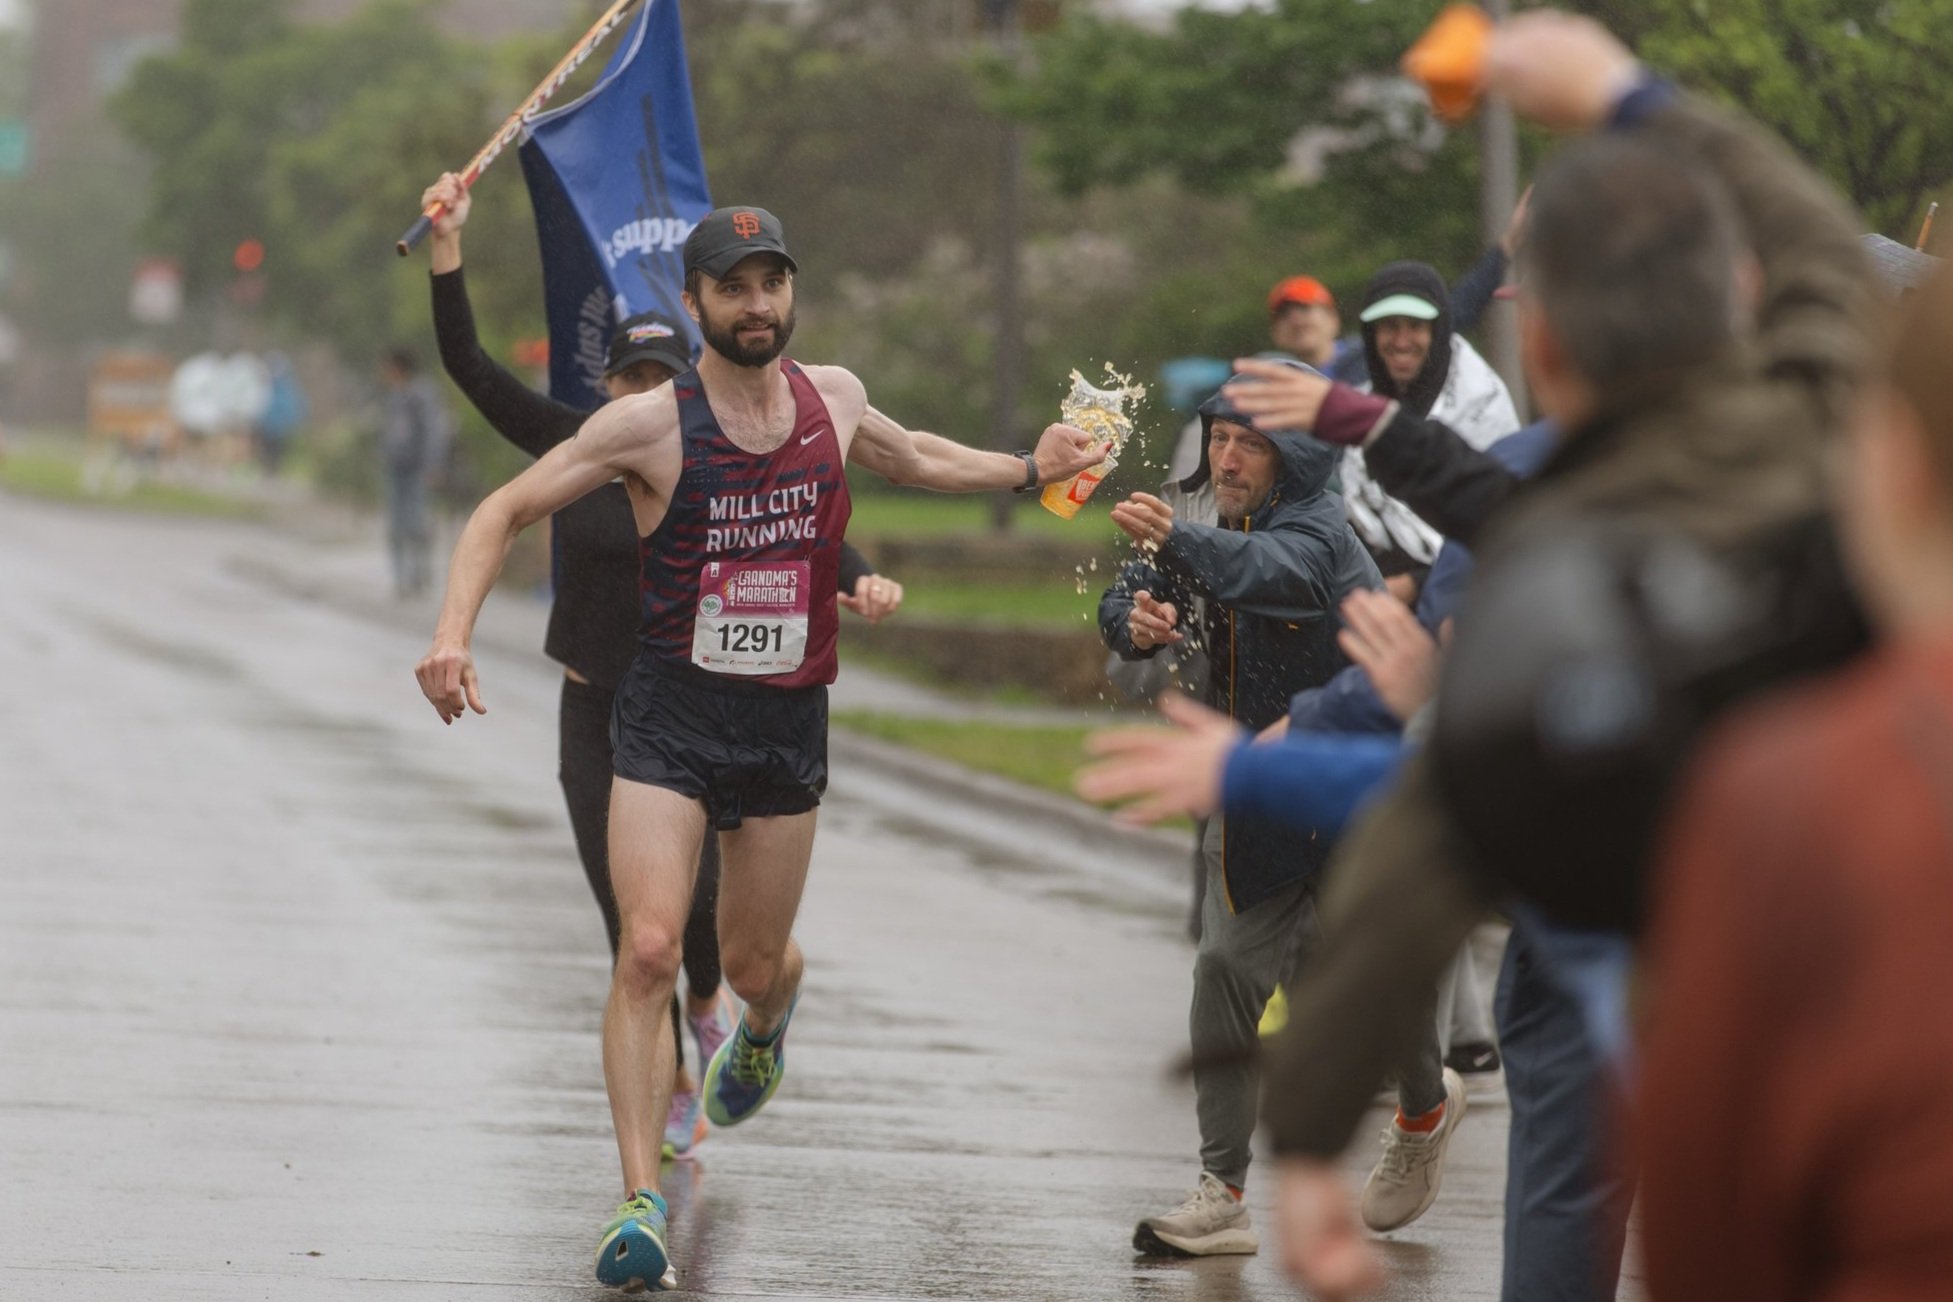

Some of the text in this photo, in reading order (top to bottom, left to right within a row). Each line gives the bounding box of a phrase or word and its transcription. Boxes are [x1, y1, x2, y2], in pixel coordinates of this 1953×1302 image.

[709, 481, 818, 521] MILL CITY
[706, 515, 817, 553] RUNNING
[737, 570, 798, 587] GRANDMA'S
[717, 623, 783, 653] 1291
